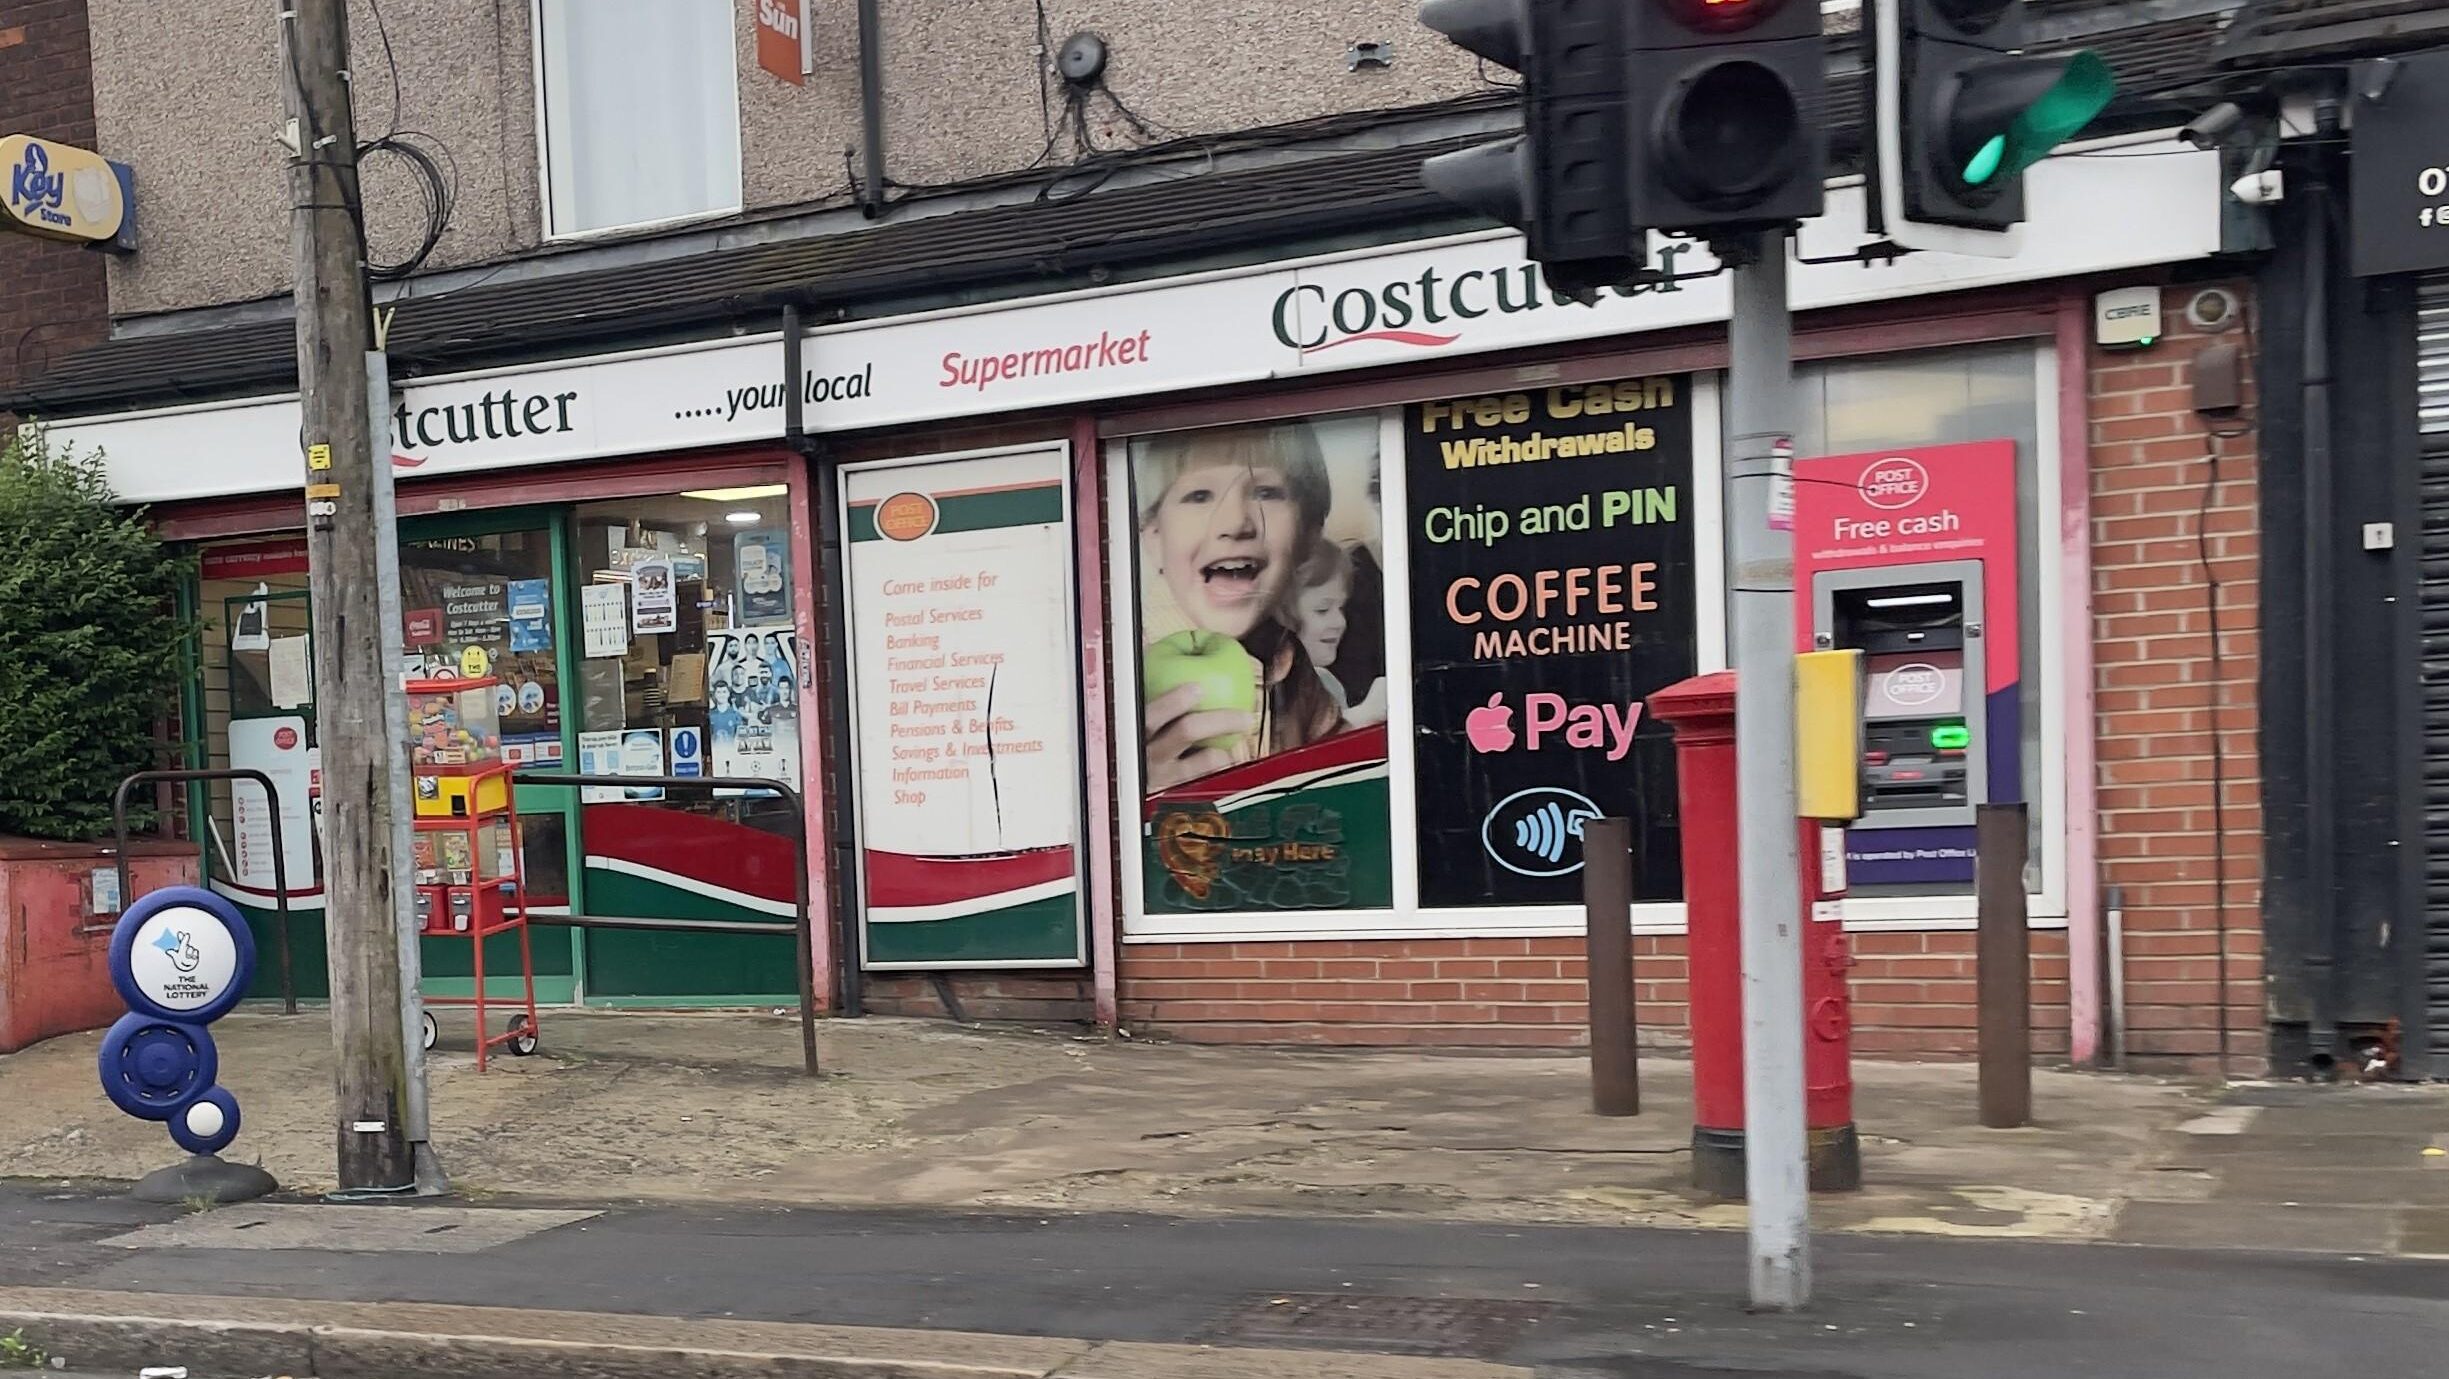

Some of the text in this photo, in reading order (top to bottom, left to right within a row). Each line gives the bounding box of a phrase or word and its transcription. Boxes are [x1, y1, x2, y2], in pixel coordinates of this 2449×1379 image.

[12, 164, 64, 209] Key
[40, 208, 72, 226] Store
[1272, 242, 1691, 350] Costcur
[803, 362, 872, 404] local
[939, 329, 1153, 391] Supermarket
[1422, 377, 1675, 433] Free Cash
[1440, 422, 1656, 470] Withdrawals
[1875, 468, 1914, 483] POST
[1866, 481, 1920, 497] OFFICE
[1425, 486, 1678, 547] Chip and PIN
[1834, 509, 1960, 541] Free cash
[443, 584, 501, 599] Welcome to
[883, 570, 999, 597] Come inside for
[1446, 562, 1659, 625] COFFEE
[446, 600, 498, 615] Costcutter
[885, 607, 983, 628] Postal Services
[887, 633, 940, 651] Banking
[1474, 621, 1632, 660] MACHINE
[888, 651, 1005, 671] Financial Services
[889, 674, 985, 694] Travel Services
[890, 699, 977, 717] Bill Payments
[891, 723, 946, 738] Pensions
[951, 719, 962, 734] &
[1525, 692, 1644, 762] Pay
[892, 745, 940, 762] Savings
[945, 741, 957, 757] &
[893, 766, 969, 784] Information
[894, 789, 927, 807] Shop
[163, 983, 209, 991] NATIONAL
[178, 975, 196, 983] THE
[166, 991, 207, 999] LOTTERY
